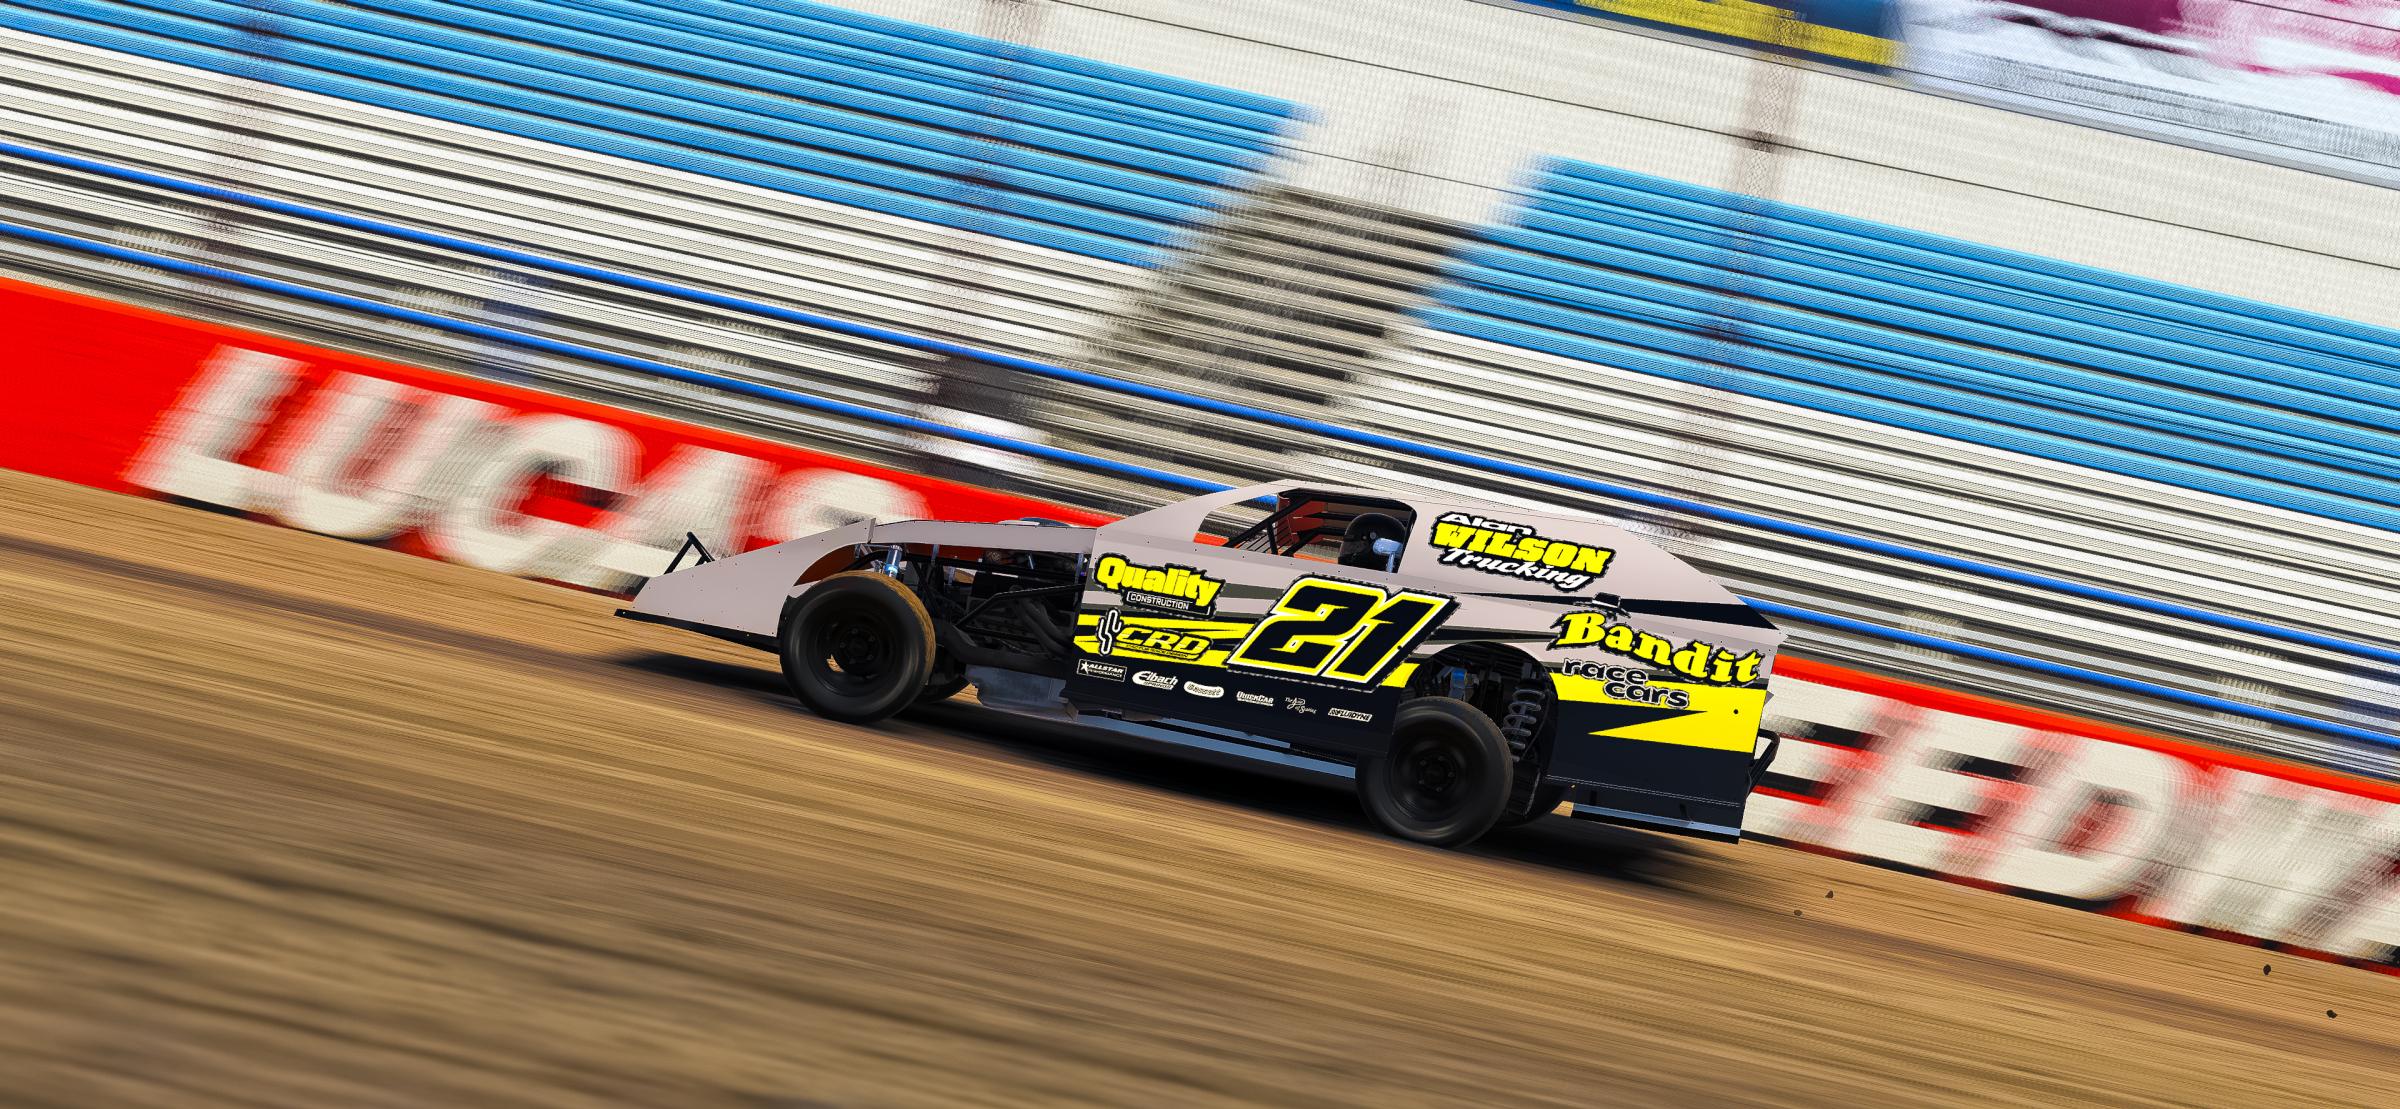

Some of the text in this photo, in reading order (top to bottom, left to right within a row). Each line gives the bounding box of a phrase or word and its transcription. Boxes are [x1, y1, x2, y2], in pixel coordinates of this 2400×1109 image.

[1439, 513, 1533, 536] Alan
[1433, 522, 1612, 574] WILSON
[1096, 556, 1222, 607] Quality
[1443, 547, 1591, 589] Trucking
[1130, 592, 1190, 610] CONSTRUCTION
[1116, 626, 1210, 655] CRD
[1227, 577, 1452, 685] 21
[1556, 612, 1763, 684] Bandit
[1088, 663, 1125, 674] ALLSTAR
[1562, 658, 1650, 685] race
[1603, 681, 1690, 709] cars
